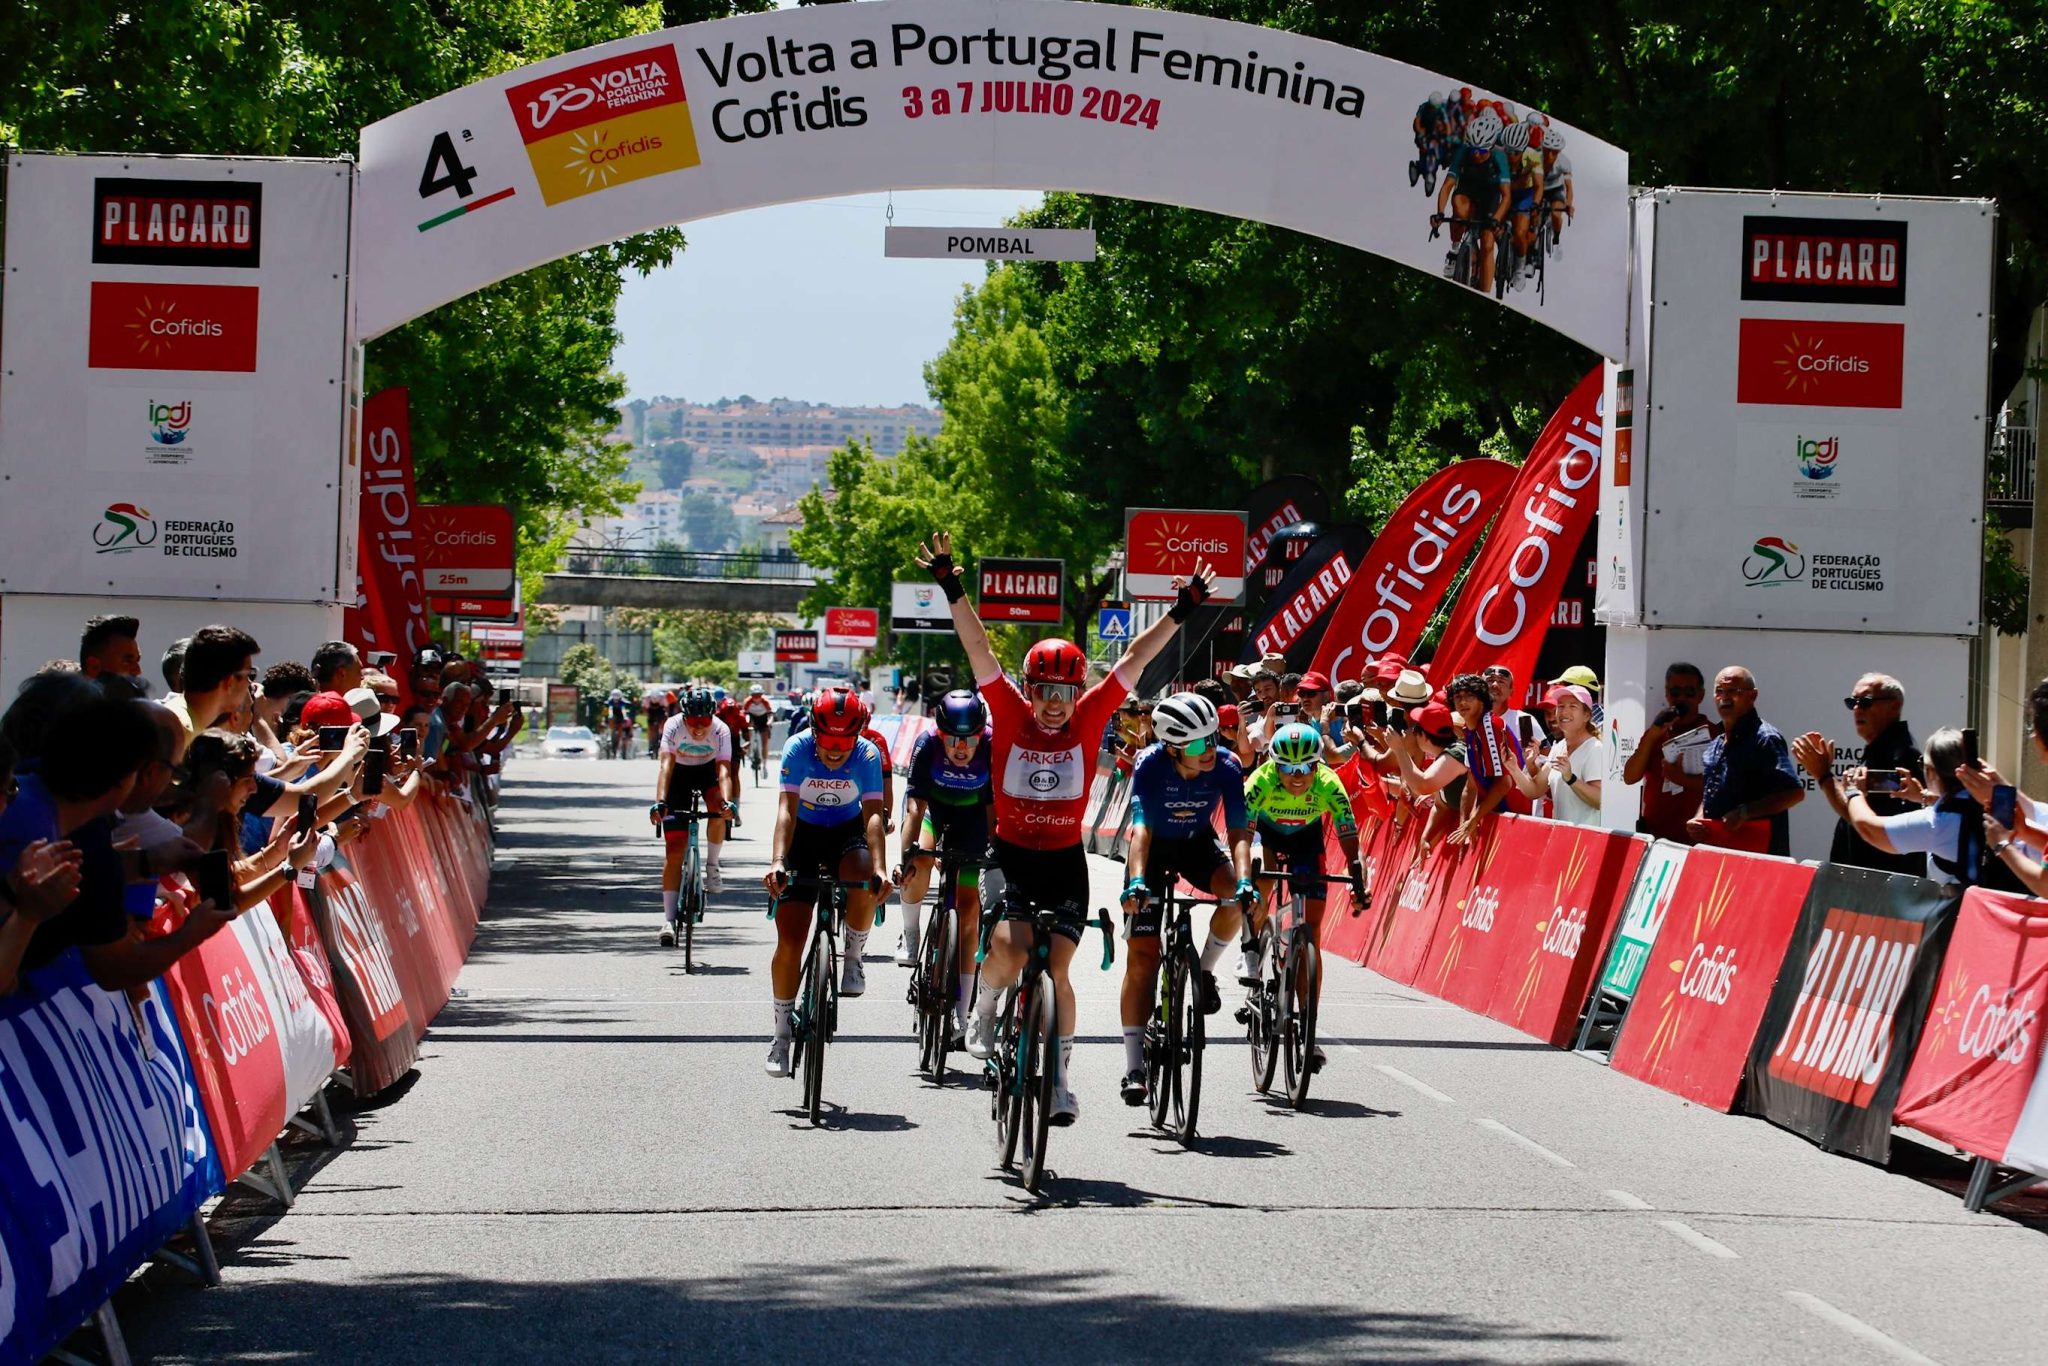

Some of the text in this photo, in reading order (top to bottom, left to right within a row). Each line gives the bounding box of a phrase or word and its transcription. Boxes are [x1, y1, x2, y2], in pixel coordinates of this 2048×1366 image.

[590, 61, 667, 92] VOLTA
[695, 22, 1365, 118] Volta a Portugal Feminina
[606, 77, 669, 100] PORTUGAL
[607, 89, 665, 109] FEMININA
[711, 81, 1162, 143] Cofidis 3 a 7 JULHO 2024
[590, 135, 663, 165] Cofidis
[104, 202, 251, 244] PLACARD
[947, 236, 1034, 254] POMBAL
[1753, 240, 1896, 282] PLACARD
[150, 318, 223, 337] Cofidis
[1798, 354, 1869, 374] Cofidis
[165, 520, 233, 535] FEDERAÇÃO
[435, 531, 496, 545] Cofidis
[1167, 537, 1228, 553] Cofidis
[164, 546, 237, 558] DE CICLISMO
[1813, 554, 1880, 569] FEDERAÇÃO
[439, 574, 468, 584] 25m
[983, 573, 1057, 595] PLACARD
[1812, 580, 1883, 591] DE CICLISMO
[461, 602, 482, 610] 50m
[1010, 607, 1030, 616] 50m
[1257, 555, 1351, 655] PLACARD
[777, 636, 816, 649] PLACARD
[1019, 751, 1073, 764] ARKEA
[808, 780, 850, 789] ARKEA
[1025, 814, 1075, 825] Cofidis
[1542, 906, 1586, 959] Cofidis
[1680, 942, 1738, 1006] Cofidis
[203, 966, 270, 1066] Cofidis
[1776, 928, 1918, 1085] PLACARD
[1959, 984, 2036, 1064] Cofidis
